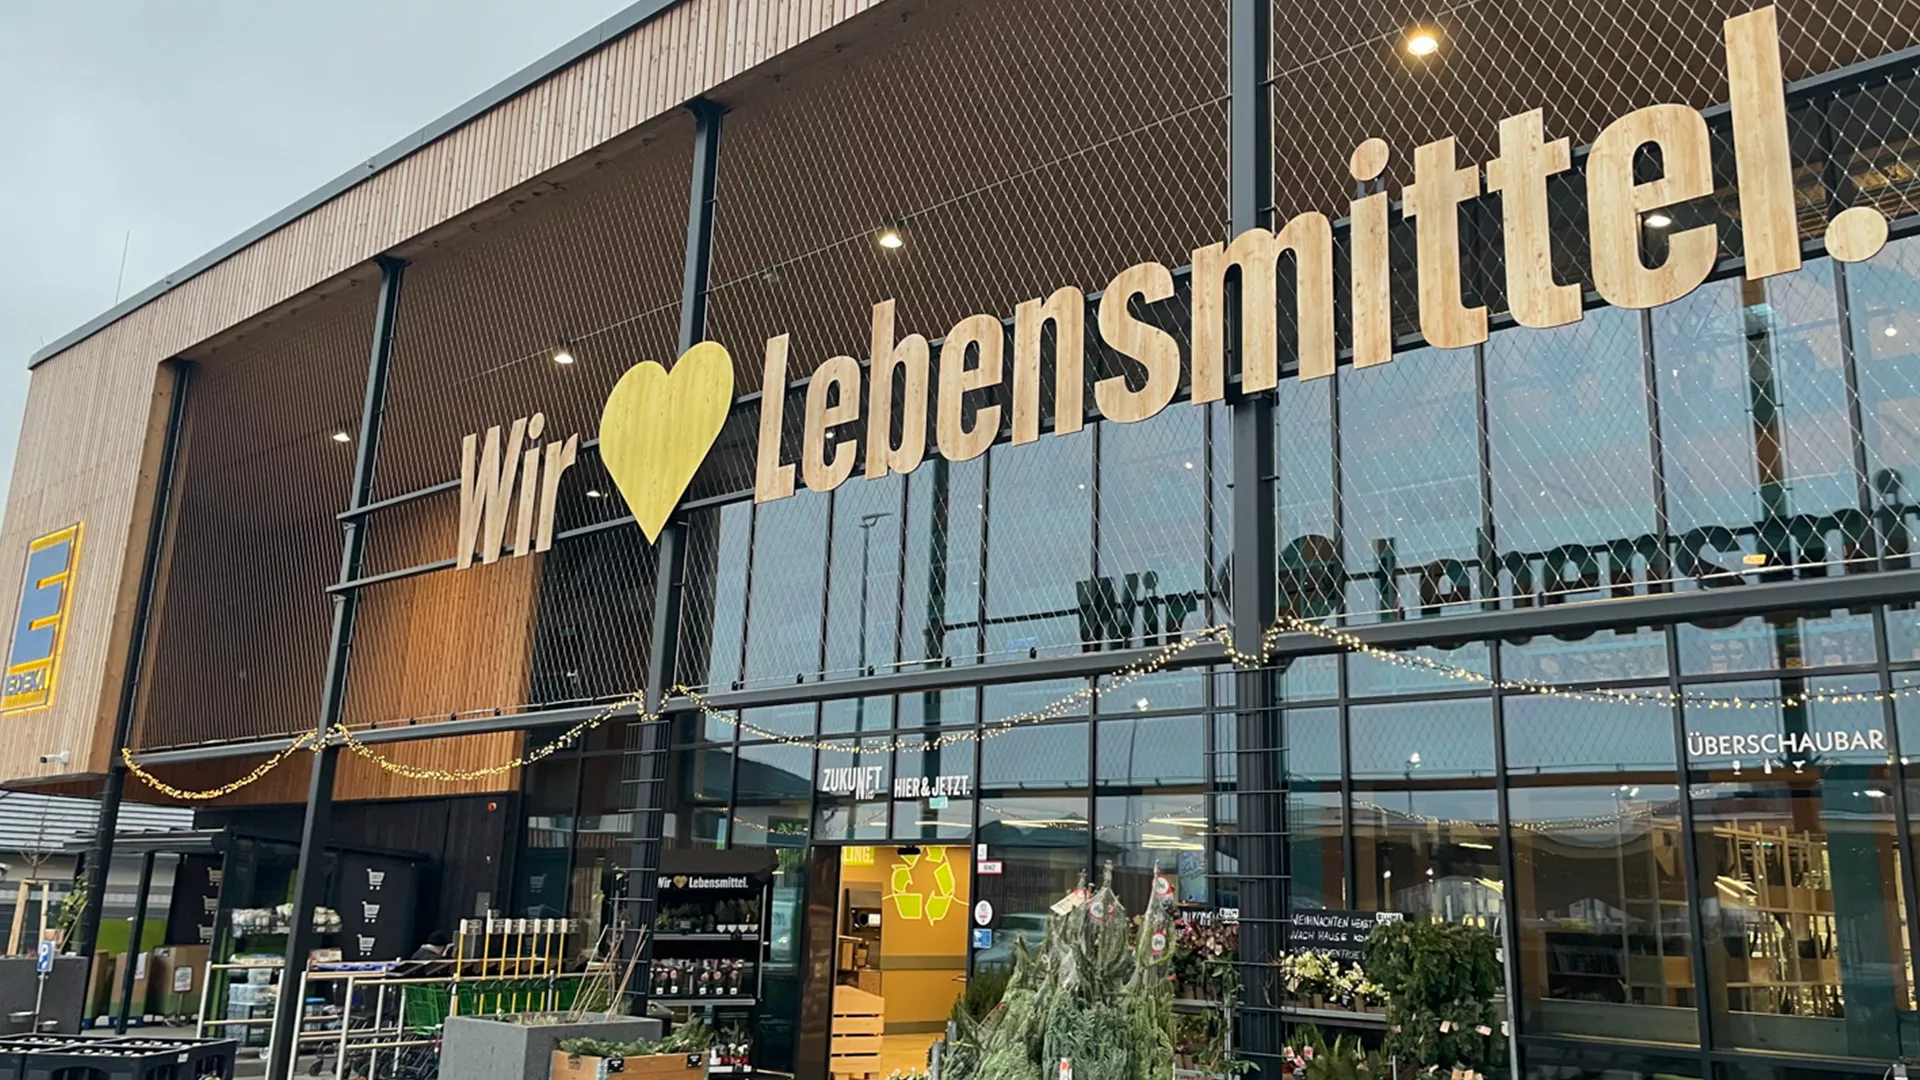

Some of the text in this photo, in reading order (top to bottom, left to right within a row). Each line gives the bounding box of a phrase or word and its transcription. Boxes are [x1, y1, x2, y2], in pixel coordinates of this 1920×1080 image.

[457, 5, 1889, 570] Wir Lebensmittel.
[5, 669, 46, 695] EDEKA
[1687, 730, 1885, 756] ÜBERSCHAUBAR
[822, 766, 882, 799] ZUKUNFT
[688, 876, 749, 888] Lebensmittel.
